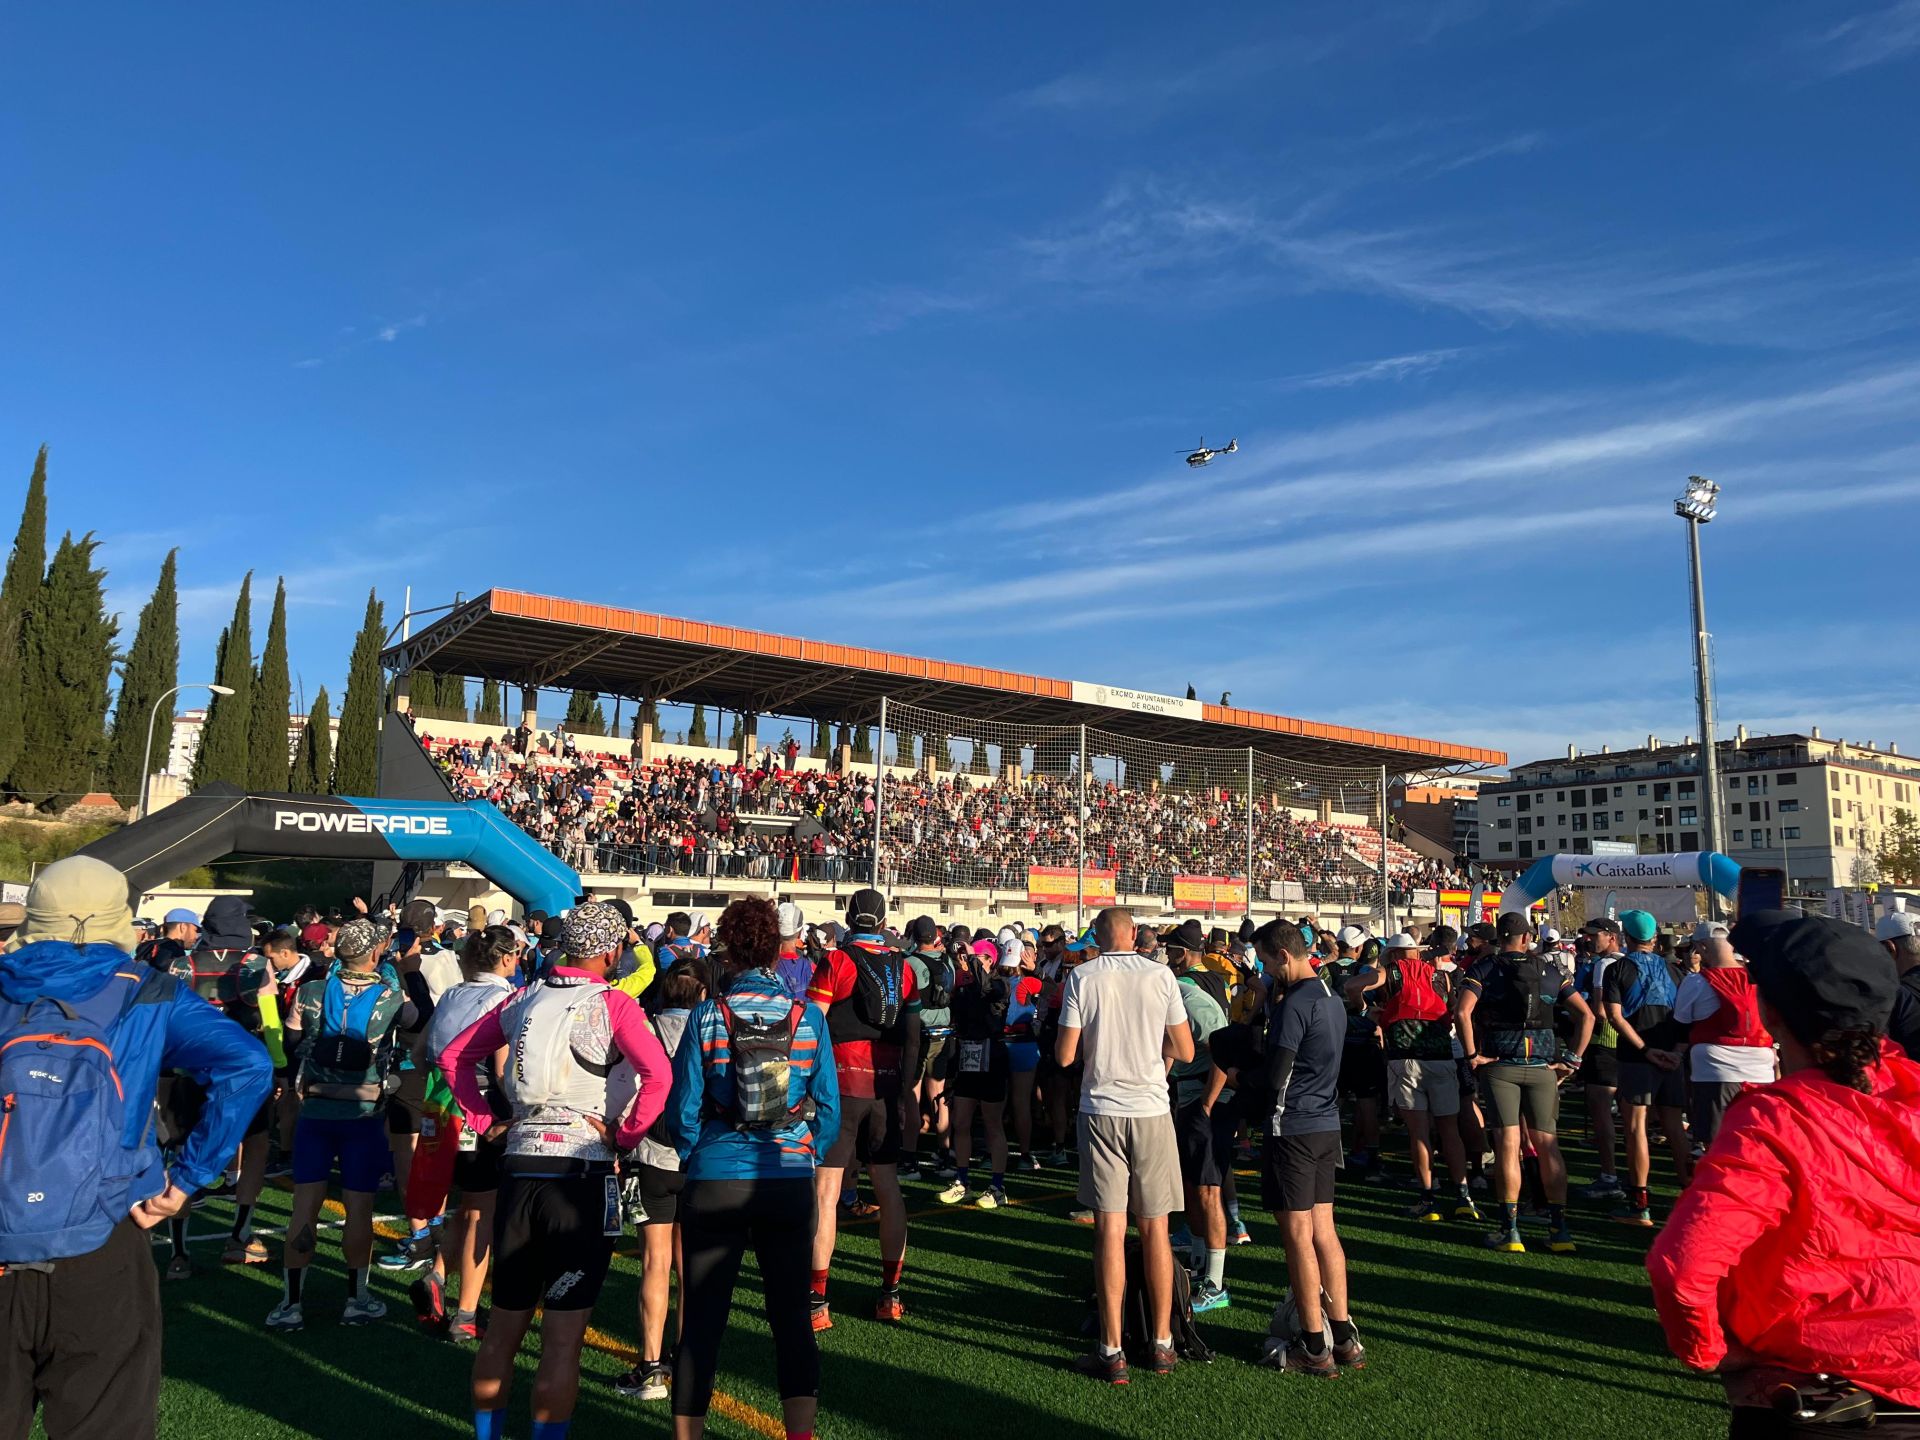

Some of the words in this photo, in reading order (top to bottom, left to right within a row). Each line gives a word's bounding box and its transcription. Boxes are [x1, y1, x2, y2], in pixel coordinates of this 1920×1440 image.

[1131, 701, 1141, 709] DE
[1142, 703, 1164, 712] RONDA
[1137, 693, 1184, 707] AYUNTAMIENTO
[274, 811, 448, 835] POWERADE
[1596, 862, 1672, 877] CaixaBank
[885, 964, 895, 1006] AONIJIE
[515, 1017, 532, 1086] SALOMON
[27, 1192, 45, 1203] 20
